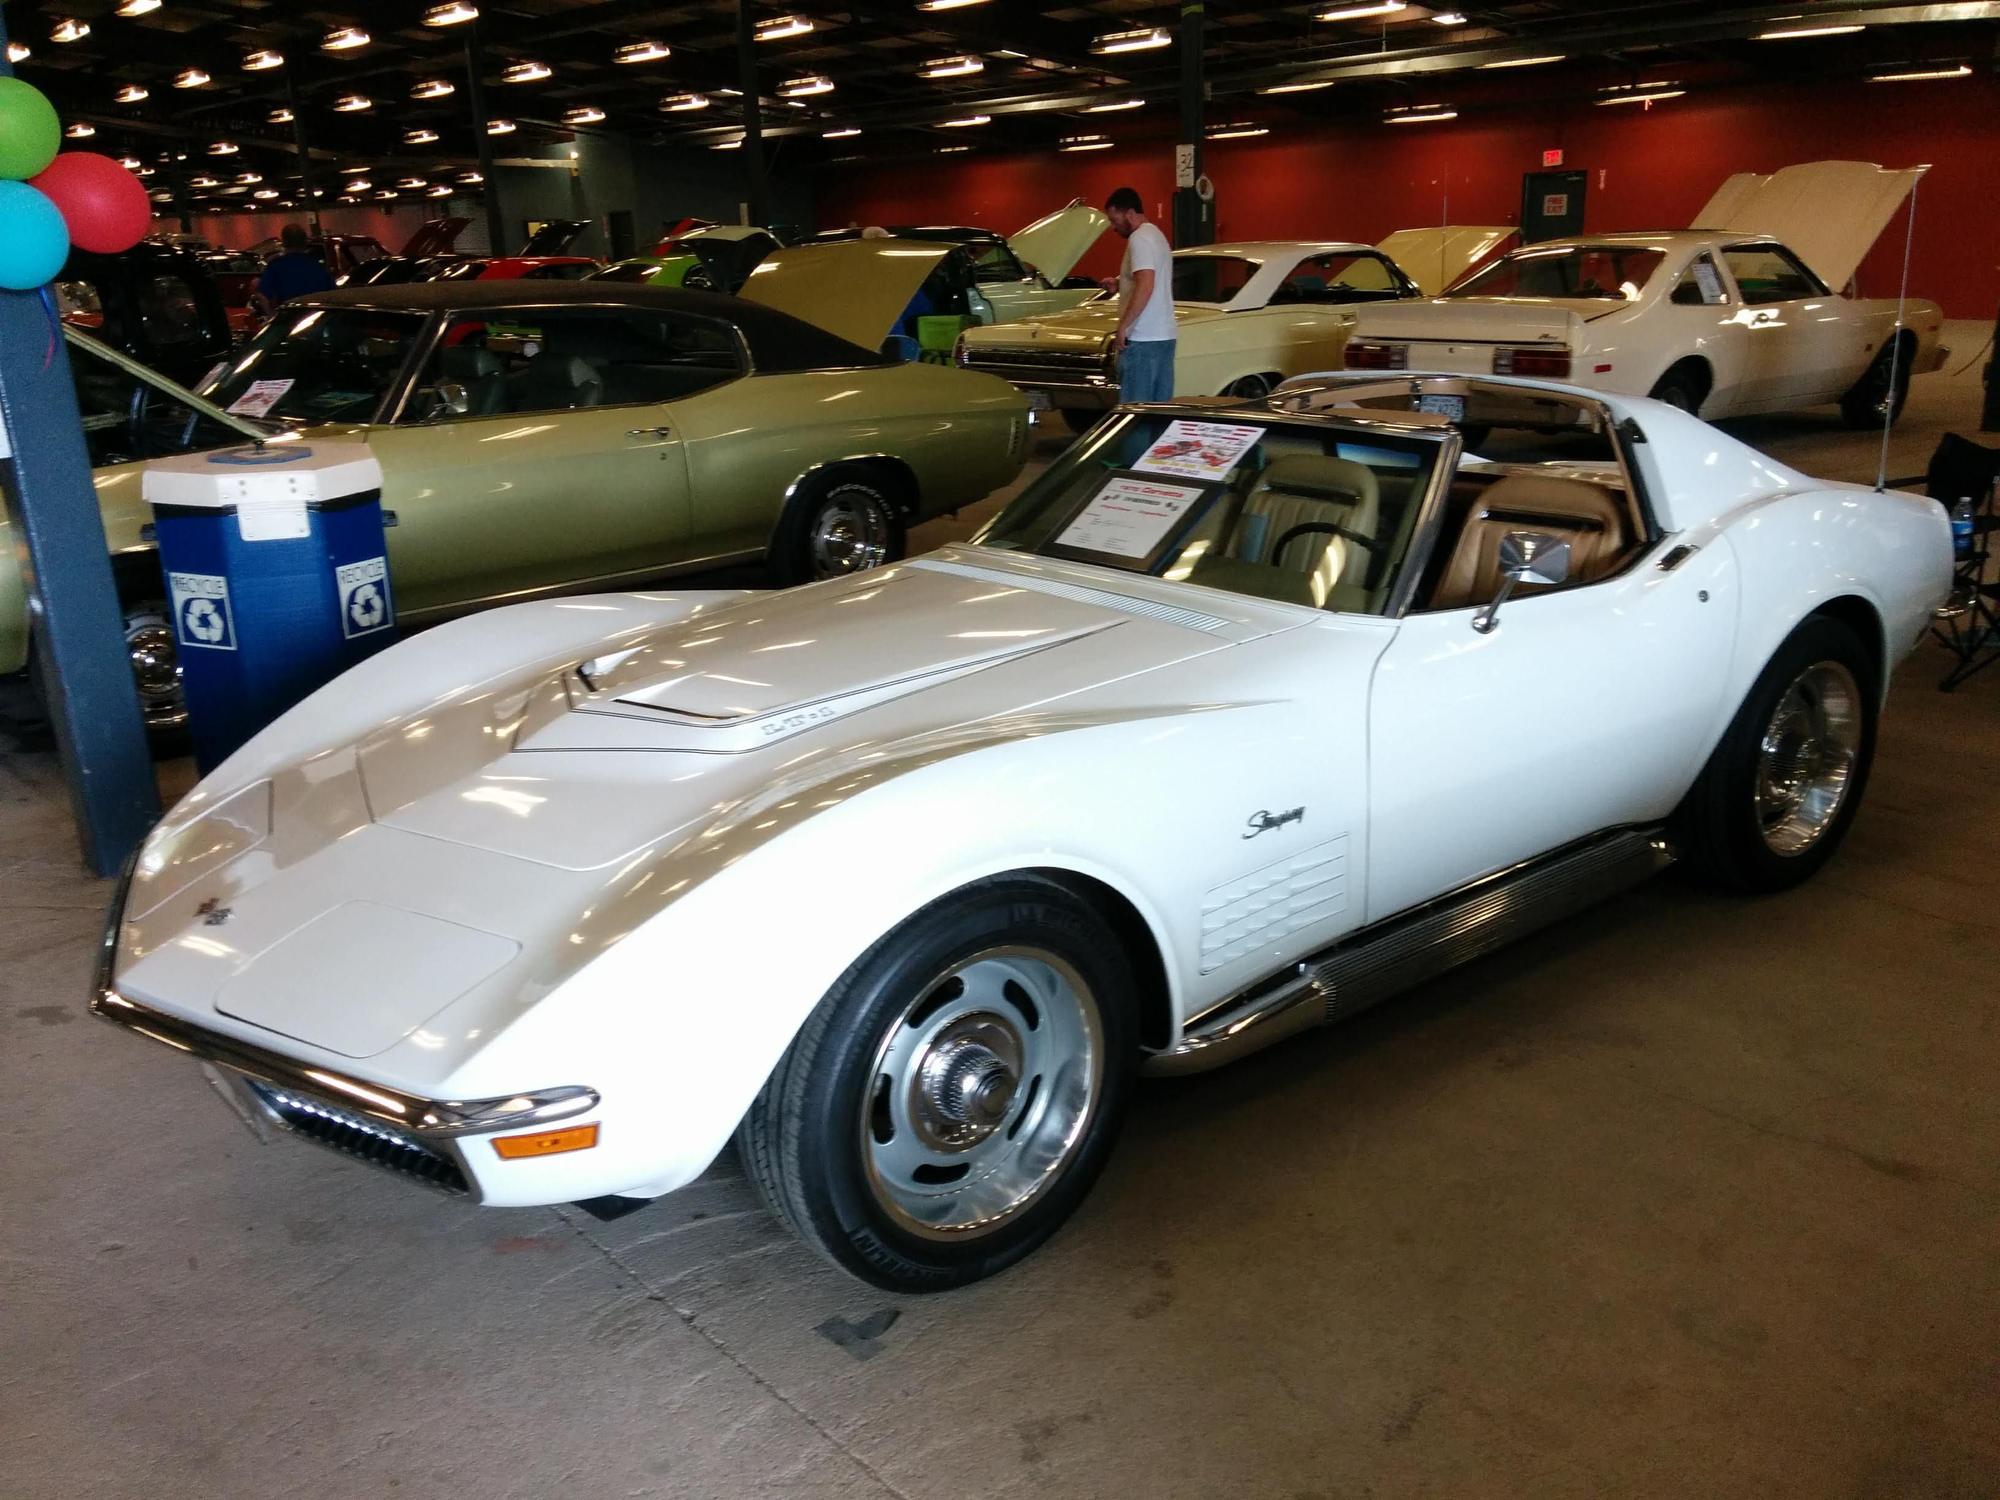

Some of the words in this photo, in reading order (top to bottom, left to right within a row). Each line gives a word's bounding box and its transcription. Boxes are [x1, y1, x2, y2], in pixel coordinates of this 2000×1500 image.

[1141, 486, 1185, 499] Corvette
[340, 560, 385, 584] RECYCLE
[172, 576, 225, 596] RECYCLE
